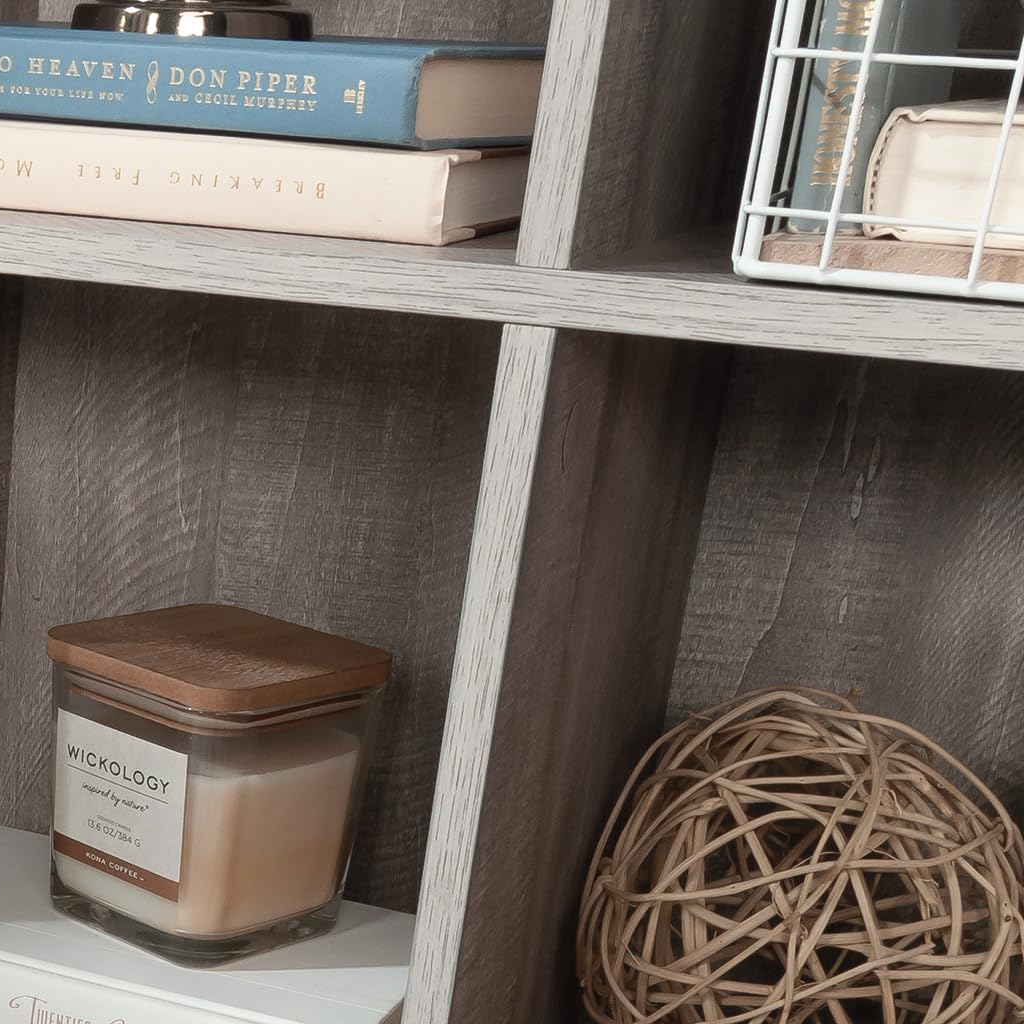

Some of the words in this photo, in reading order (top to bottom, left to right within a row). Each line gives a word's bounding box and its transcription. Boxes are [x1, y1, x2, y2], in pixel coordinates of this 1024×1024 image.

[27, 57, 136, 81] HEAVEN
[169, 66, 227, 89] DON
[237, 70, 318, 95] PIPER
[10, 84, 31, 95] FOR
[35, 86, 64, 97] YOUR
[168, 93, 189, 103] AND
[194, 92, 238, 106] CECIL
[244, 95, 318, 112] MURPHEY
[77, 164, 141, 186] FREE
[169, 171, 327, 200] BREAKING
[67, 743, 171, 795] WICKOLOGY
[82, 780, 111, 800] inspired
[110, 789, 122, 808] by
[134, 838, 141, 848] G
[85, 851, 107, 866] KONA
[108, 861, 138, 879] COFFEE
